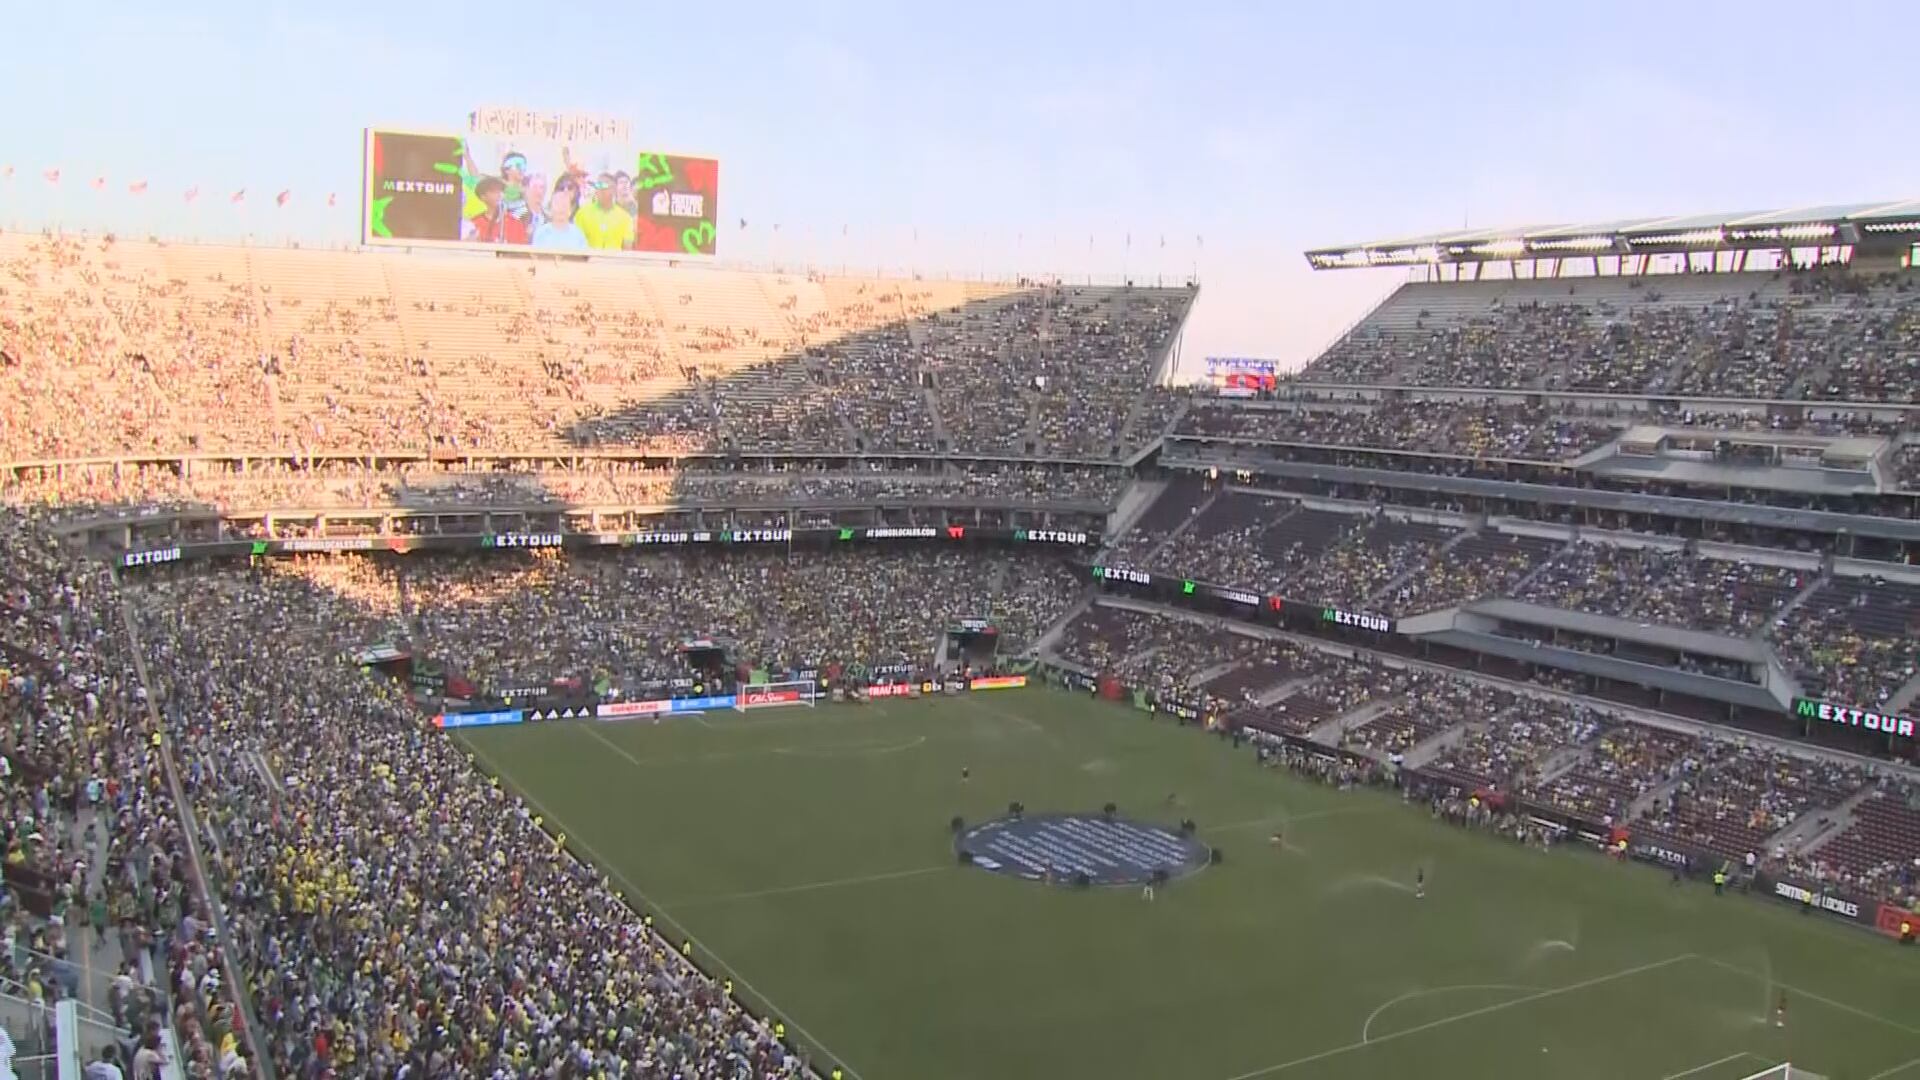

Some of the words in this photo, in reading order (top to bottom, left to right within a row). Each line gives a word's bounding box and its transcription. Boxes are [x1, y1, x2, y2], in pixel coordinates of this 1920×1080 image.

[383, 180, 455, 194] MEXTOUR
[481, 534, 563, 547] MEXTOUR
[624, 532, 688, 544] MEXTOUR
[720, 530, 792, 542] MEXTOUR
[1014, 529, 1087, 544] MEXTOUR
[1092, 566, 1150, 585] MEXTOUR
[1322, 608, 1389, 632] MEXTOUR
[1797, 699, 1915, 738] MEXTOUR
[1821, 895, 1859, 917] LOCALES
